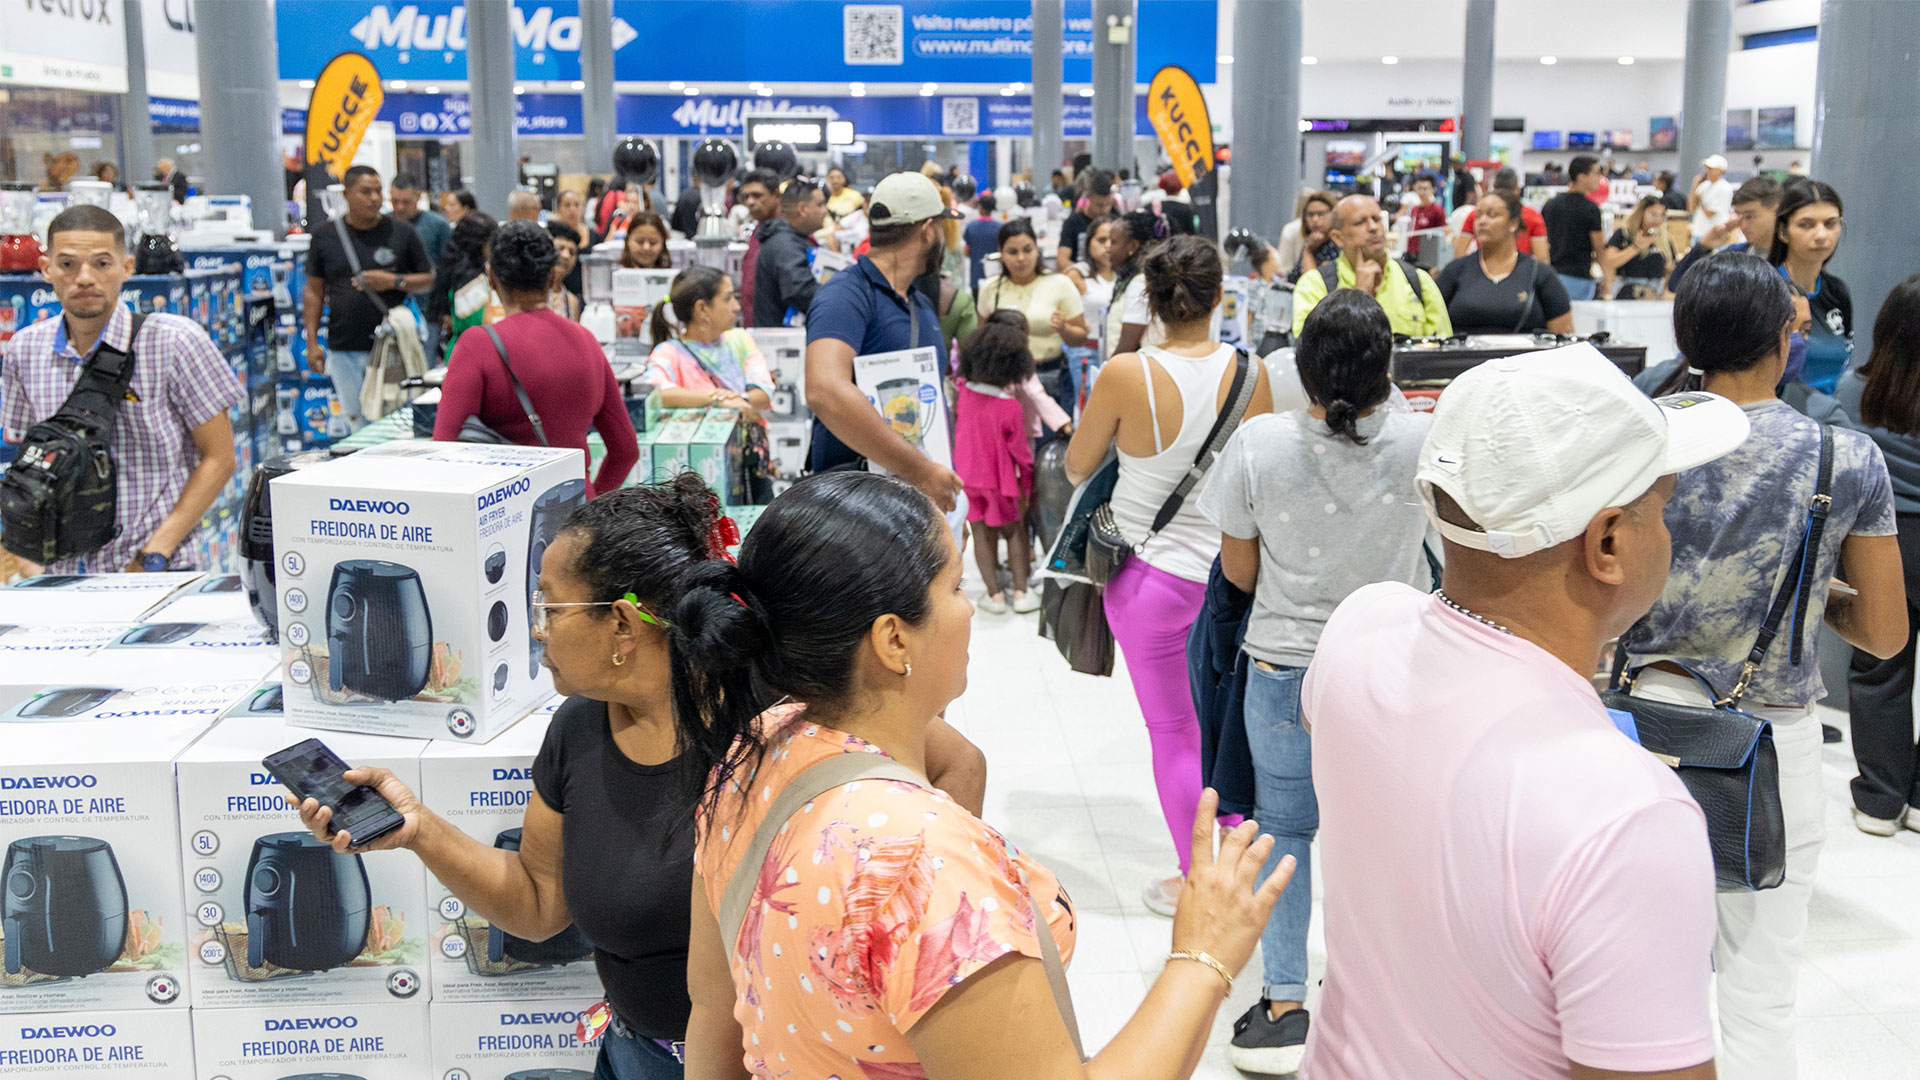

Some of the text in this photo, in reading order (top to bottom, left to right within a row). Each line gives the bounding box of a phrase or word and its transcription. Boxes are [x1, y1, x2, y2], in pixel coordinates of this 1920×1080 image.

[912, 14, 952, 31] Visita
[954, 16, 1012, 31] nuestra
[478, 477, 531, 511] DAEWOO
[329, 498, 410, 515] DAEWOO
[479, 507, 506, 526] AIR FRYER
[310, 520, 433, 543] FREIDORA DE AIRE
[307, 538, 358, 546] TEMPORIZADOR
[405, 545, 454, 553] TEMPERATURA
[288, 556, 299, 571] 5L
[288, 593, 303, 604] 1400
[292, 627, 304, 638] 30
[94, 708, 220, 719] DAEWOO
[1, 775, 97, 789] DAEWOO
[250, 773, 283, 785] DA
[63, 799, 84, 814] DE
[89, 797, 125, 813] AIRE
[43, 816, 80, 824] CONTROL
[94, 814, 150, 822] TEMPERATURA
[222, 813, 282, 821] TEMPORIZADOR
[200, 836, 213, 849] 5L
[199, 873, 217, 884] 1400
[203, 907, 217, 918] 30
[445, 901, 459, 912] 30
[264, 1016, 358, 1031] DAEWOO
[21, 1024, 117, 1039] DAEWOO
[242, 1037, 384, 1057] FREIDORA DE AIRE
[478, 1034, 553, 1050] FREIDORA
[559, 1034, 579, 1049] DE
[0, 1046, 144, 1065] FREIDORA DE AIRE
[237, 1057, 297, 1066] TEMPORIZADOR
[354, 1052, 408, 1060] TEMPERATURA
[475, 1051, 531, 1059] TEMPORIZADOR
